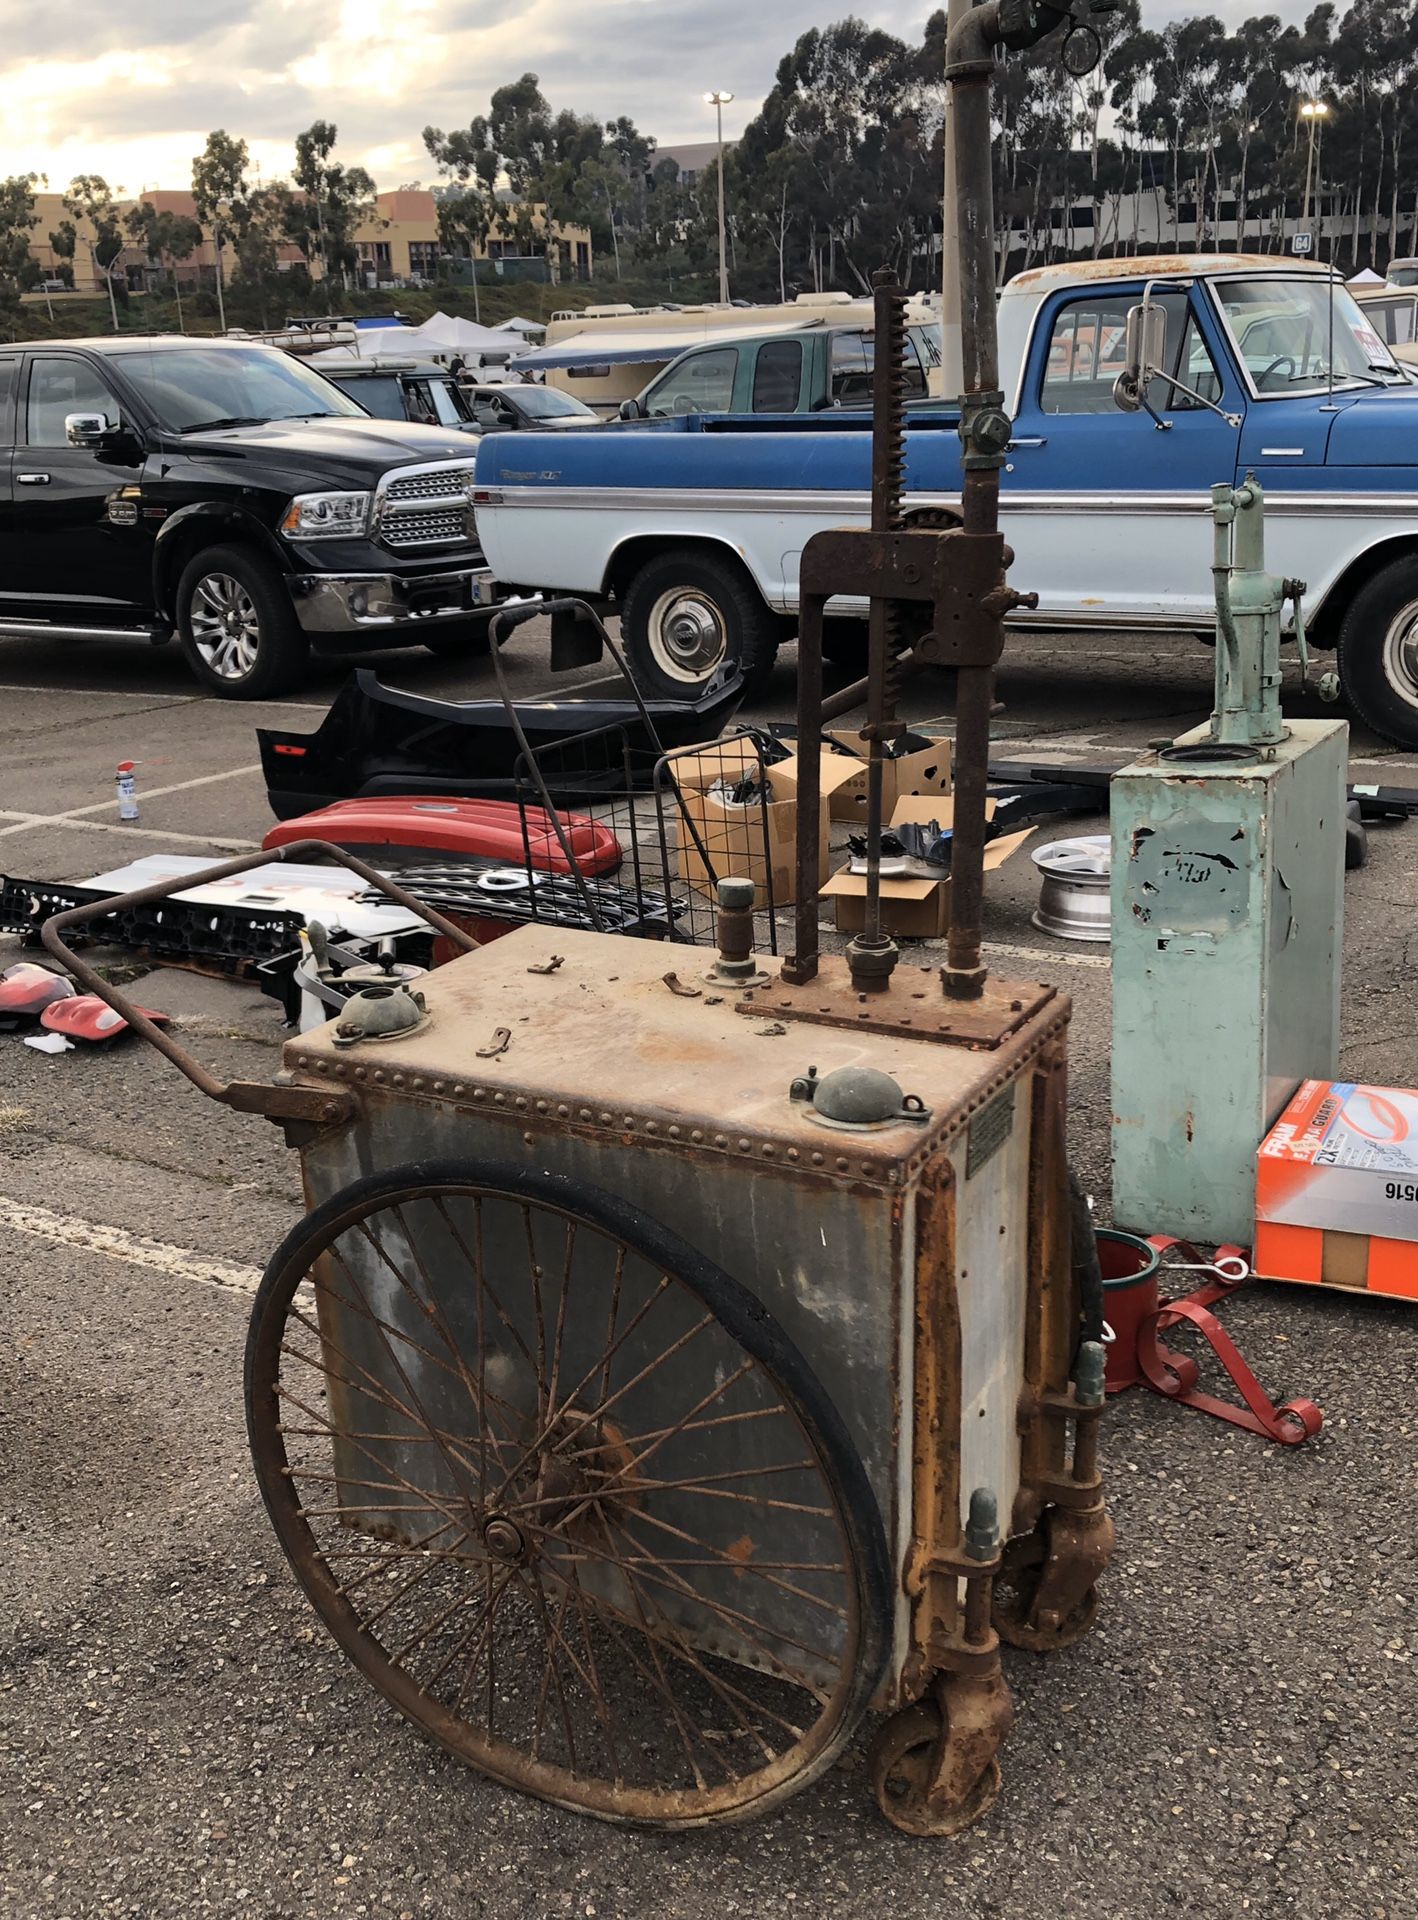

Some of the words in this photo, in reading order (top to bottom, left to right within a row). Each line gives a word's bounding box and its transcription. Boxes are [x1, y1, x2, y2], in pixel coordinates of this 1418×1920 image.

[1295, 236, 1308, 250] 64
[1263, 1122, 1298, 1158] FRAM
[1293, 1124, 1322, 1161] ERA
[1312, 1098, 1337, 1127] GUARD
[1317, 1149, 1340, 1164] 2X
